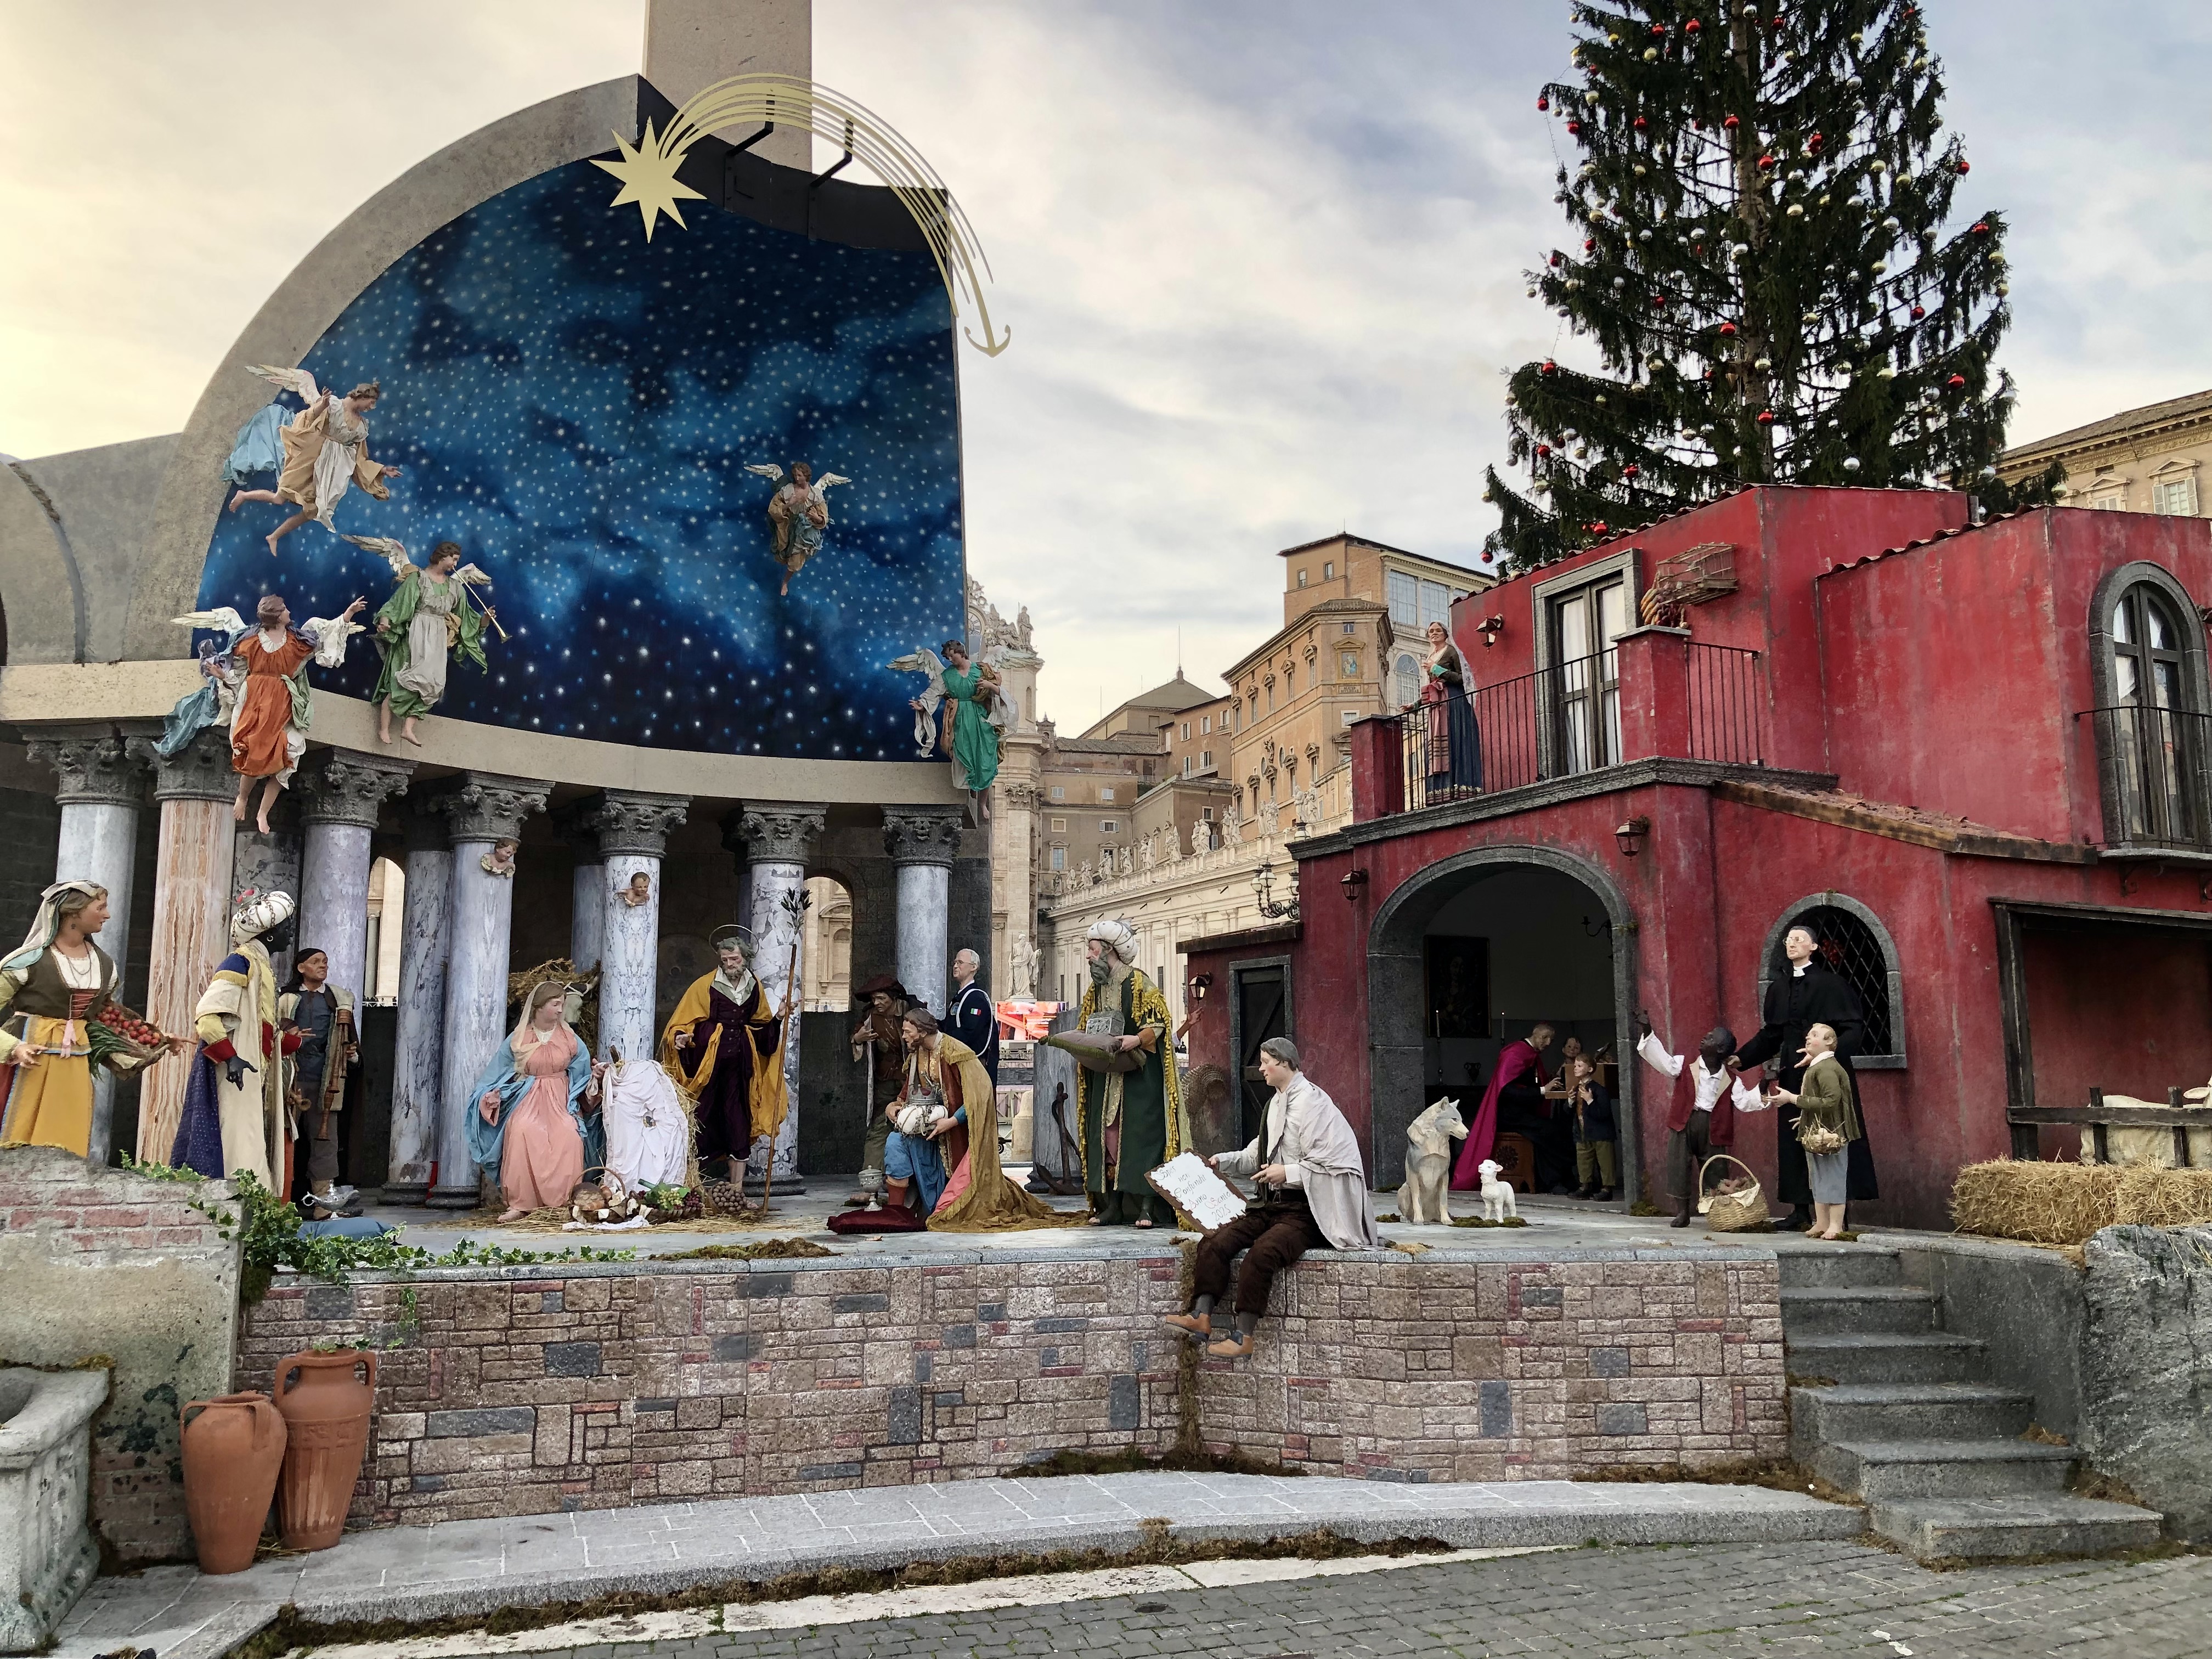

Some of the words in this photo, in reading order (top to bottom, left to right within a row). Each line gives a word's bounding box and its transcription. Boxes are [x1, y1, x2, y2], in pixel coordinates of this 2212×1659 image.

[1154, 1165, 1176, 1181] Spes
[1178, 1173, 1190, 1183] non
[1188, 1193, 1207, 1210] Anno
[1204, 1191, 1231, 1209] Santo
[1211, 1204, 1231, 1221] 2025
